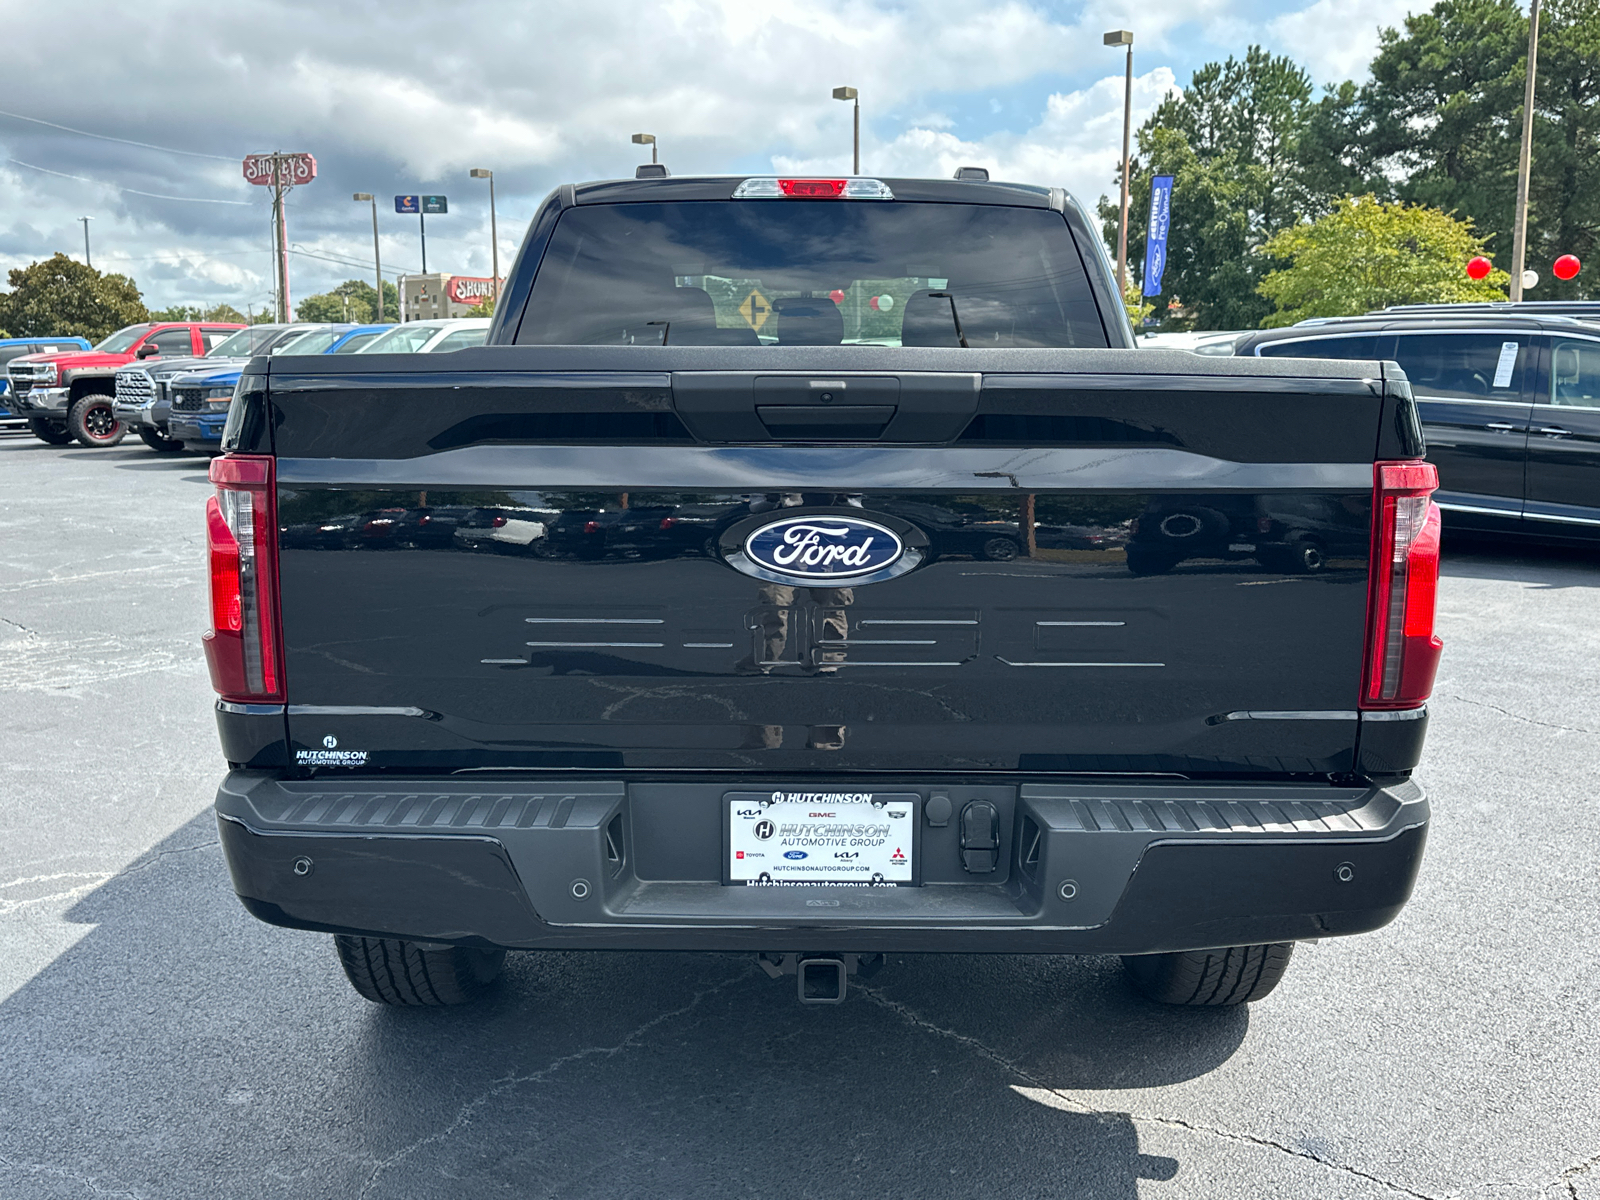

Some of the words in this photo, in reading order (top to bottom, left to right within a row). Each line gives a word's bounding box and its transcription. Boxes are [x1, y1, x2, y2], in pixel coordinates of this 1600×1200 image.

[246, 158, 308, 179] SHOEY'S
[1151, 187, 1160, 240] CERTIFIED
[1158, 187, 1169, 240] Pre-Owned
[772, 524, 875, 567] Ford
[296, 750, 367, 760] HUTCHINSON
[787, 793, 872, 804] HUTCHINSON
[779, 823, 891, 838] HUTCHINSON
[780, 838, 847, 847] AUTOMOTIVE
[849, 838, 885, 847] GROUP
[786, 851, 805, 859] Ford
[746, 880, 897, 888] Hutchinsonautogroupcom
